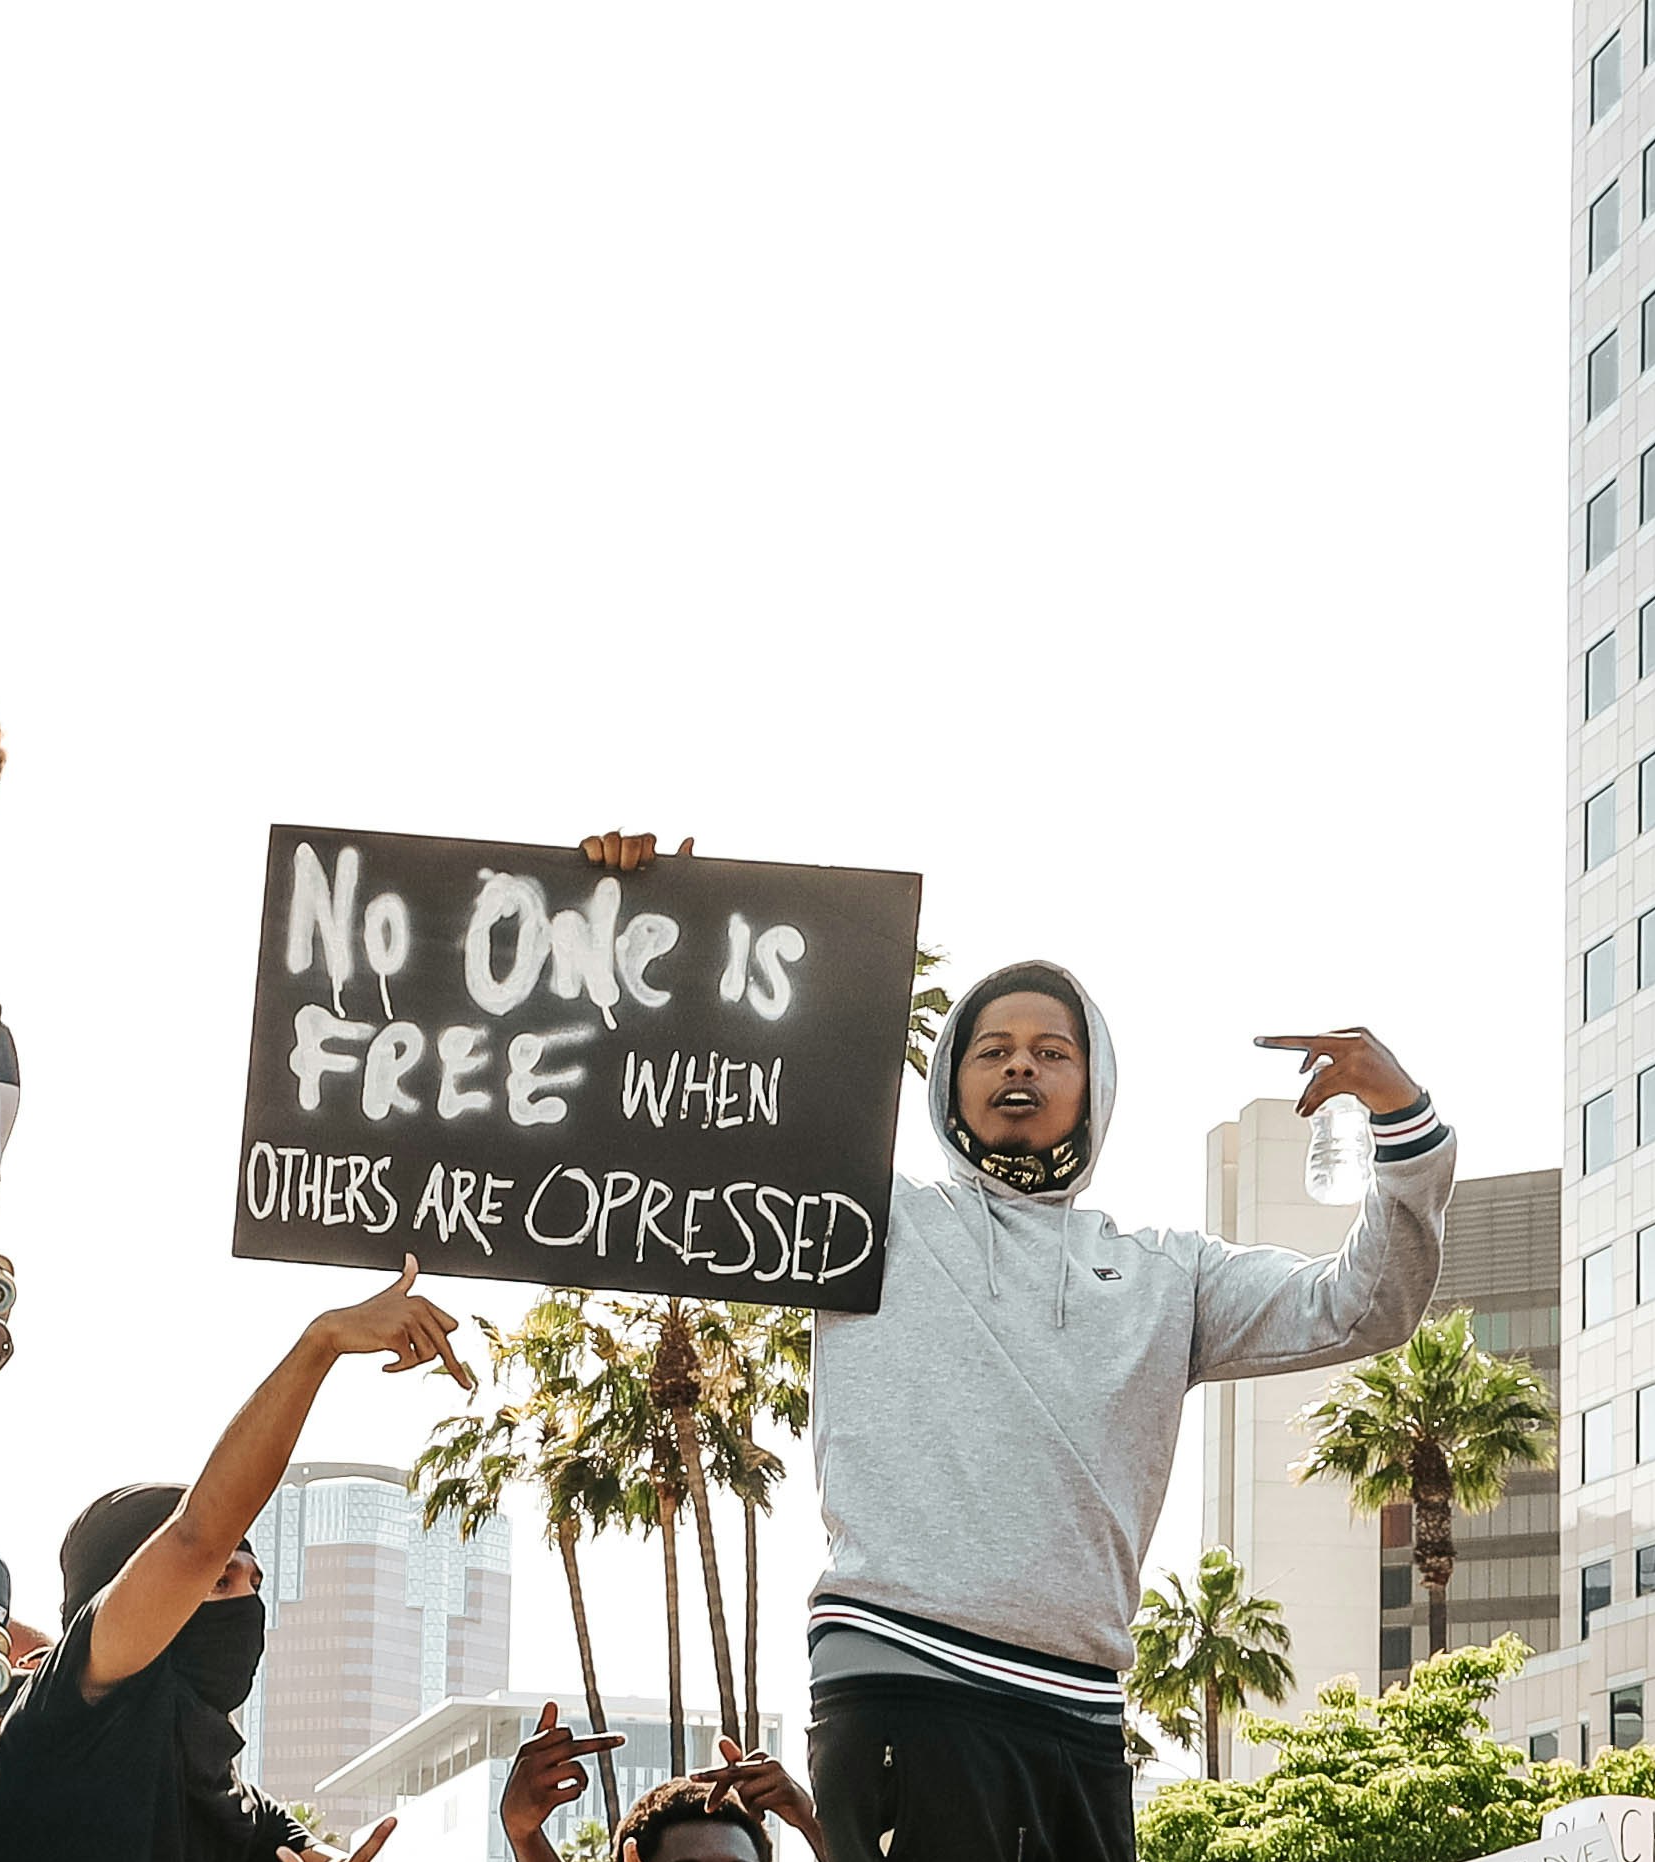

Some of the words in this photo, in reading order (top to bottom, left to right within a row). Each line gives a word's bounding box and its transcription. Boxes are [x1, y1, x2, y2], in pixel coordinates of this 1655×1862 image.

[289, 841, 410, 990] No
[290, 1003, 596, 1127] FREE
[621, 1050, 782, 1128] WHEN
[246, 1141, 397, 1234] OTHERS
[412, 1161, 515, 1257] ARE
[524, 1163, 875, 1285] OPRESSED
